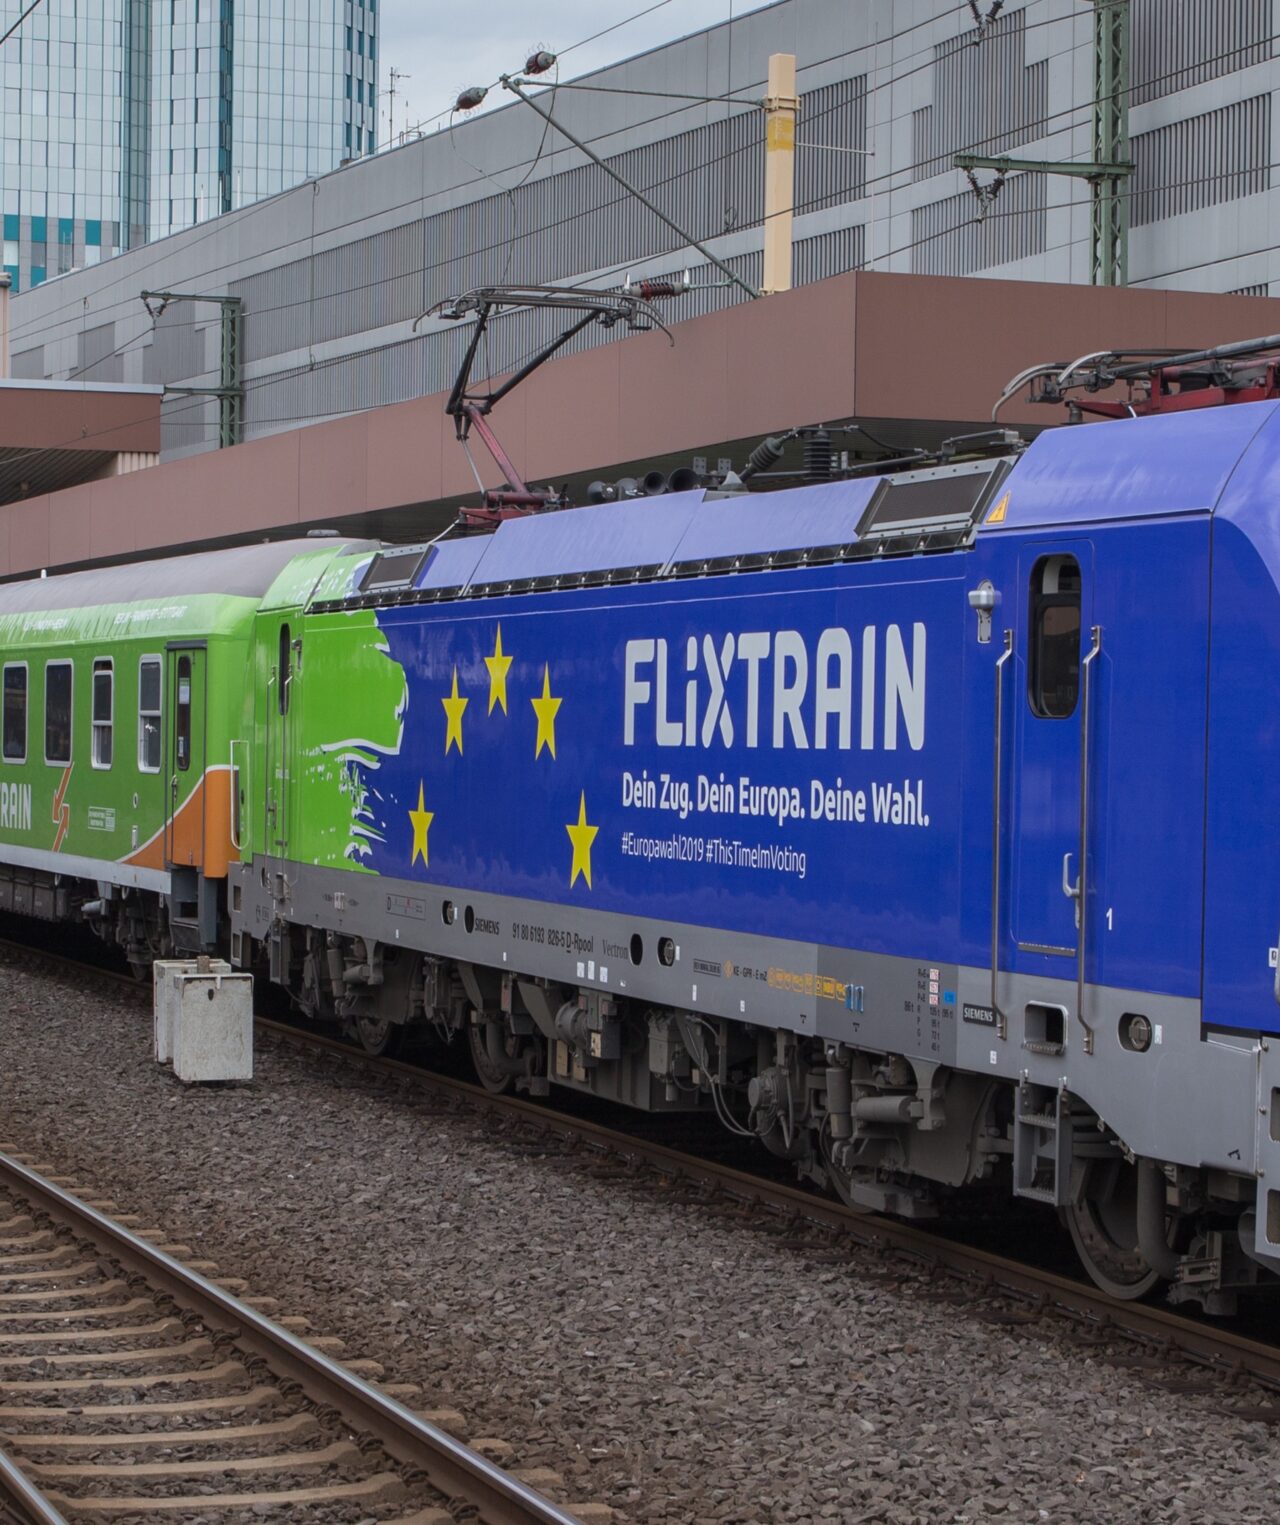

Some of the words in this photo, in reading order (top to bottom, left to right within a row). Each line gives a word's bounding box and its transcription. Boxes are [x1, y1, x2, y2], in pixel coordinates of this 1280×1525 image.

[0, 782, 32, 830] RAIN
[622, 769, 656, 808] Dein
[660, 773, 693, 820] Zug.
[697, 772, 734, 814] Dein
[739, 776, 805, 826] Europa.
[810, 777, 866, 823] Deine
[872, 779, 930, 827] Wahl.
[621, 831, 704, 862] #Europawahl2019
[705, 838, 806, 880] #ThisTimeImVoting
[474, 917, 500, 936] SIEMENS
[1106, 908, 1113, 931] 1
[512, 922, 520, 939] 91
[521, 924, 529, 941] 80
[530, 926, 545, 944] 6193
[547, 929, 566, 948] 826-5
[602, 939, 629, 960] Vectron
[964, 1007, 993, 1022] SIEMENS
